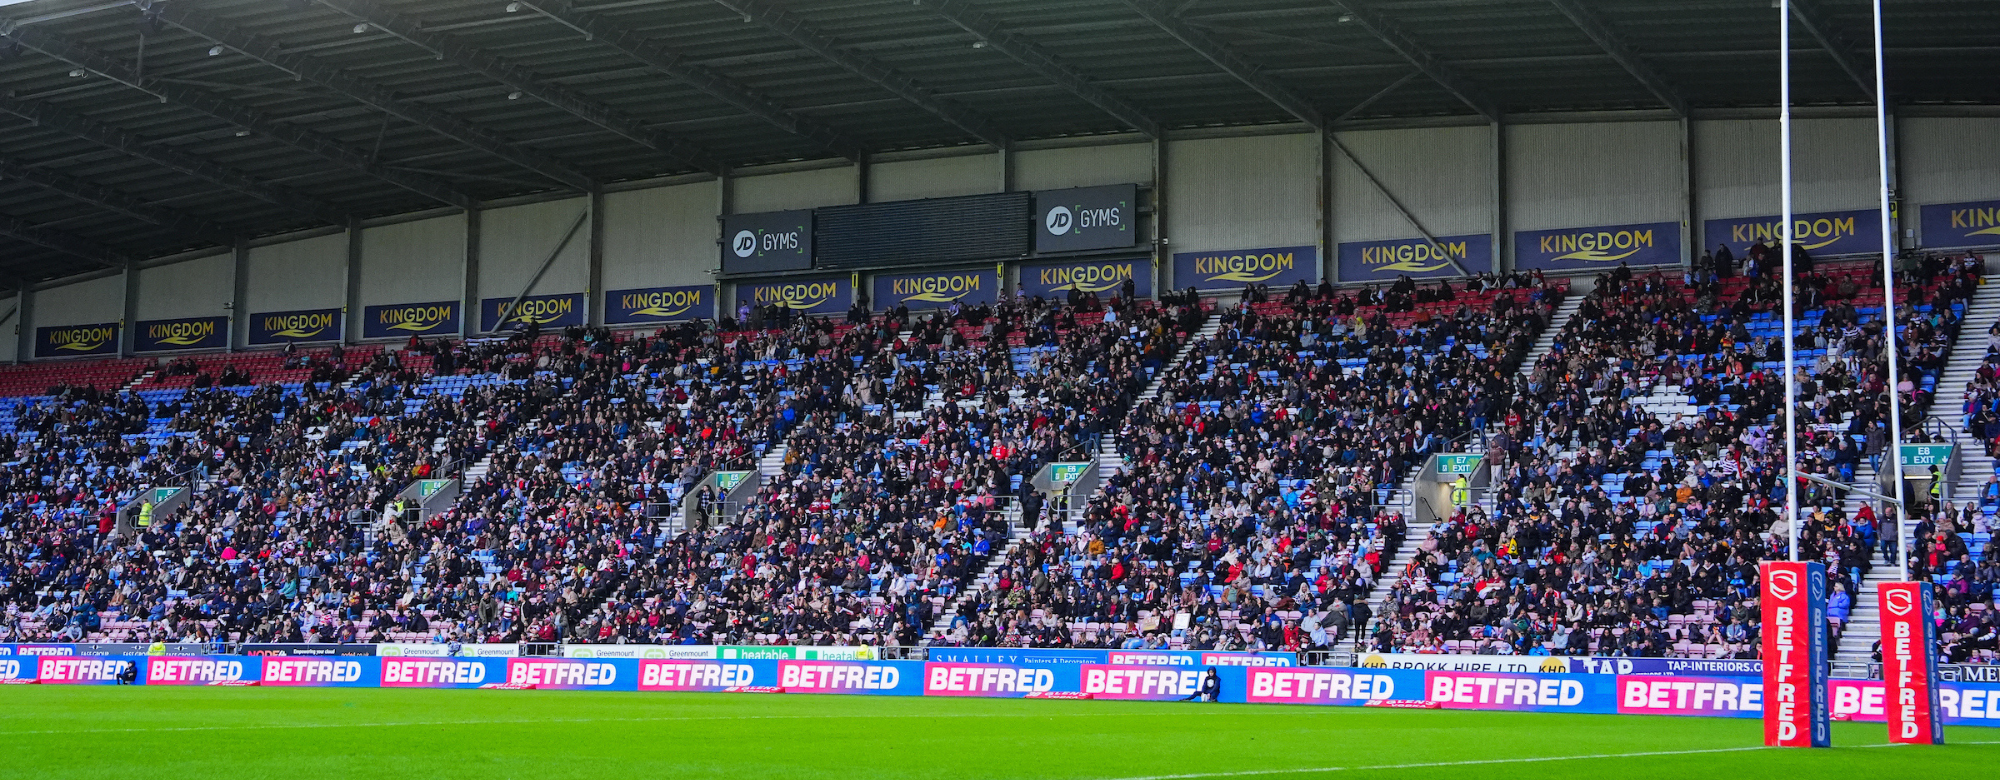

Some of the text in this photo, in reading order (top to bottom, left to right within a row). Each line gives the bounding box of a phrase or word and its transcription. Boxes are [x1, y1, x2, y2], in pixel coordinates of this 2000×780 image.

[1050, 207, 1120, 228] JD GYMS
[1952, 207, 2000, 228] KIN
[736, 232, 798, 252] JD GYMS
[1540, 230, 1653, 253] KINGDOM
[1196, 252, 1293, 274] KINGDOM
[1362, 241, 1466, 264] KINGDOM
[893, 274, 980, 294] KINGDOM
[1040, 264, 1132, 284] KINGDOM
[622, 290, 700, 308] KINGDOM
[754, 282, 836, 302] KINGDOM
[264, 313, 332, 330] KINGDOM
[380, 306, 450, 323] KINGDOM
[50, 327, 112, 344] KINGDOM
[149, 322, 214, 338] KINGDOM
[478, 648, 514, 656] Greenmount
[741, 650, 788, 659] heatable
[40, 660, 129, 680] BETFRED
[150, 660, 242, 681] BETFRED
[265, 661, 361, 682] BETFRED
[384, 662, 486, 683] BETFRED
[511, 662, 616, 685] BETFRED
[642, 664, 754, 686] BETFRED
[1583, 659, 1633, 674] TAP
[1776, 606, 1797, 740] BETFRED
[1814, 608, 1825, 742] BETFRED
[1964, 667, 2000, 682] ME
[782, 665, 900, 690] BETFRED
[929, 666, 1054, 692] BETFRED
[1252, 672, 1394, 700] BETFRED
[1894, 621, 1918, 738] BETFRED
[1927, 622, 1940, 738] BETFRED
[1431, 676, 1584, 706] BETFRED
[1624, 681, 1764, 711] BETFRE
